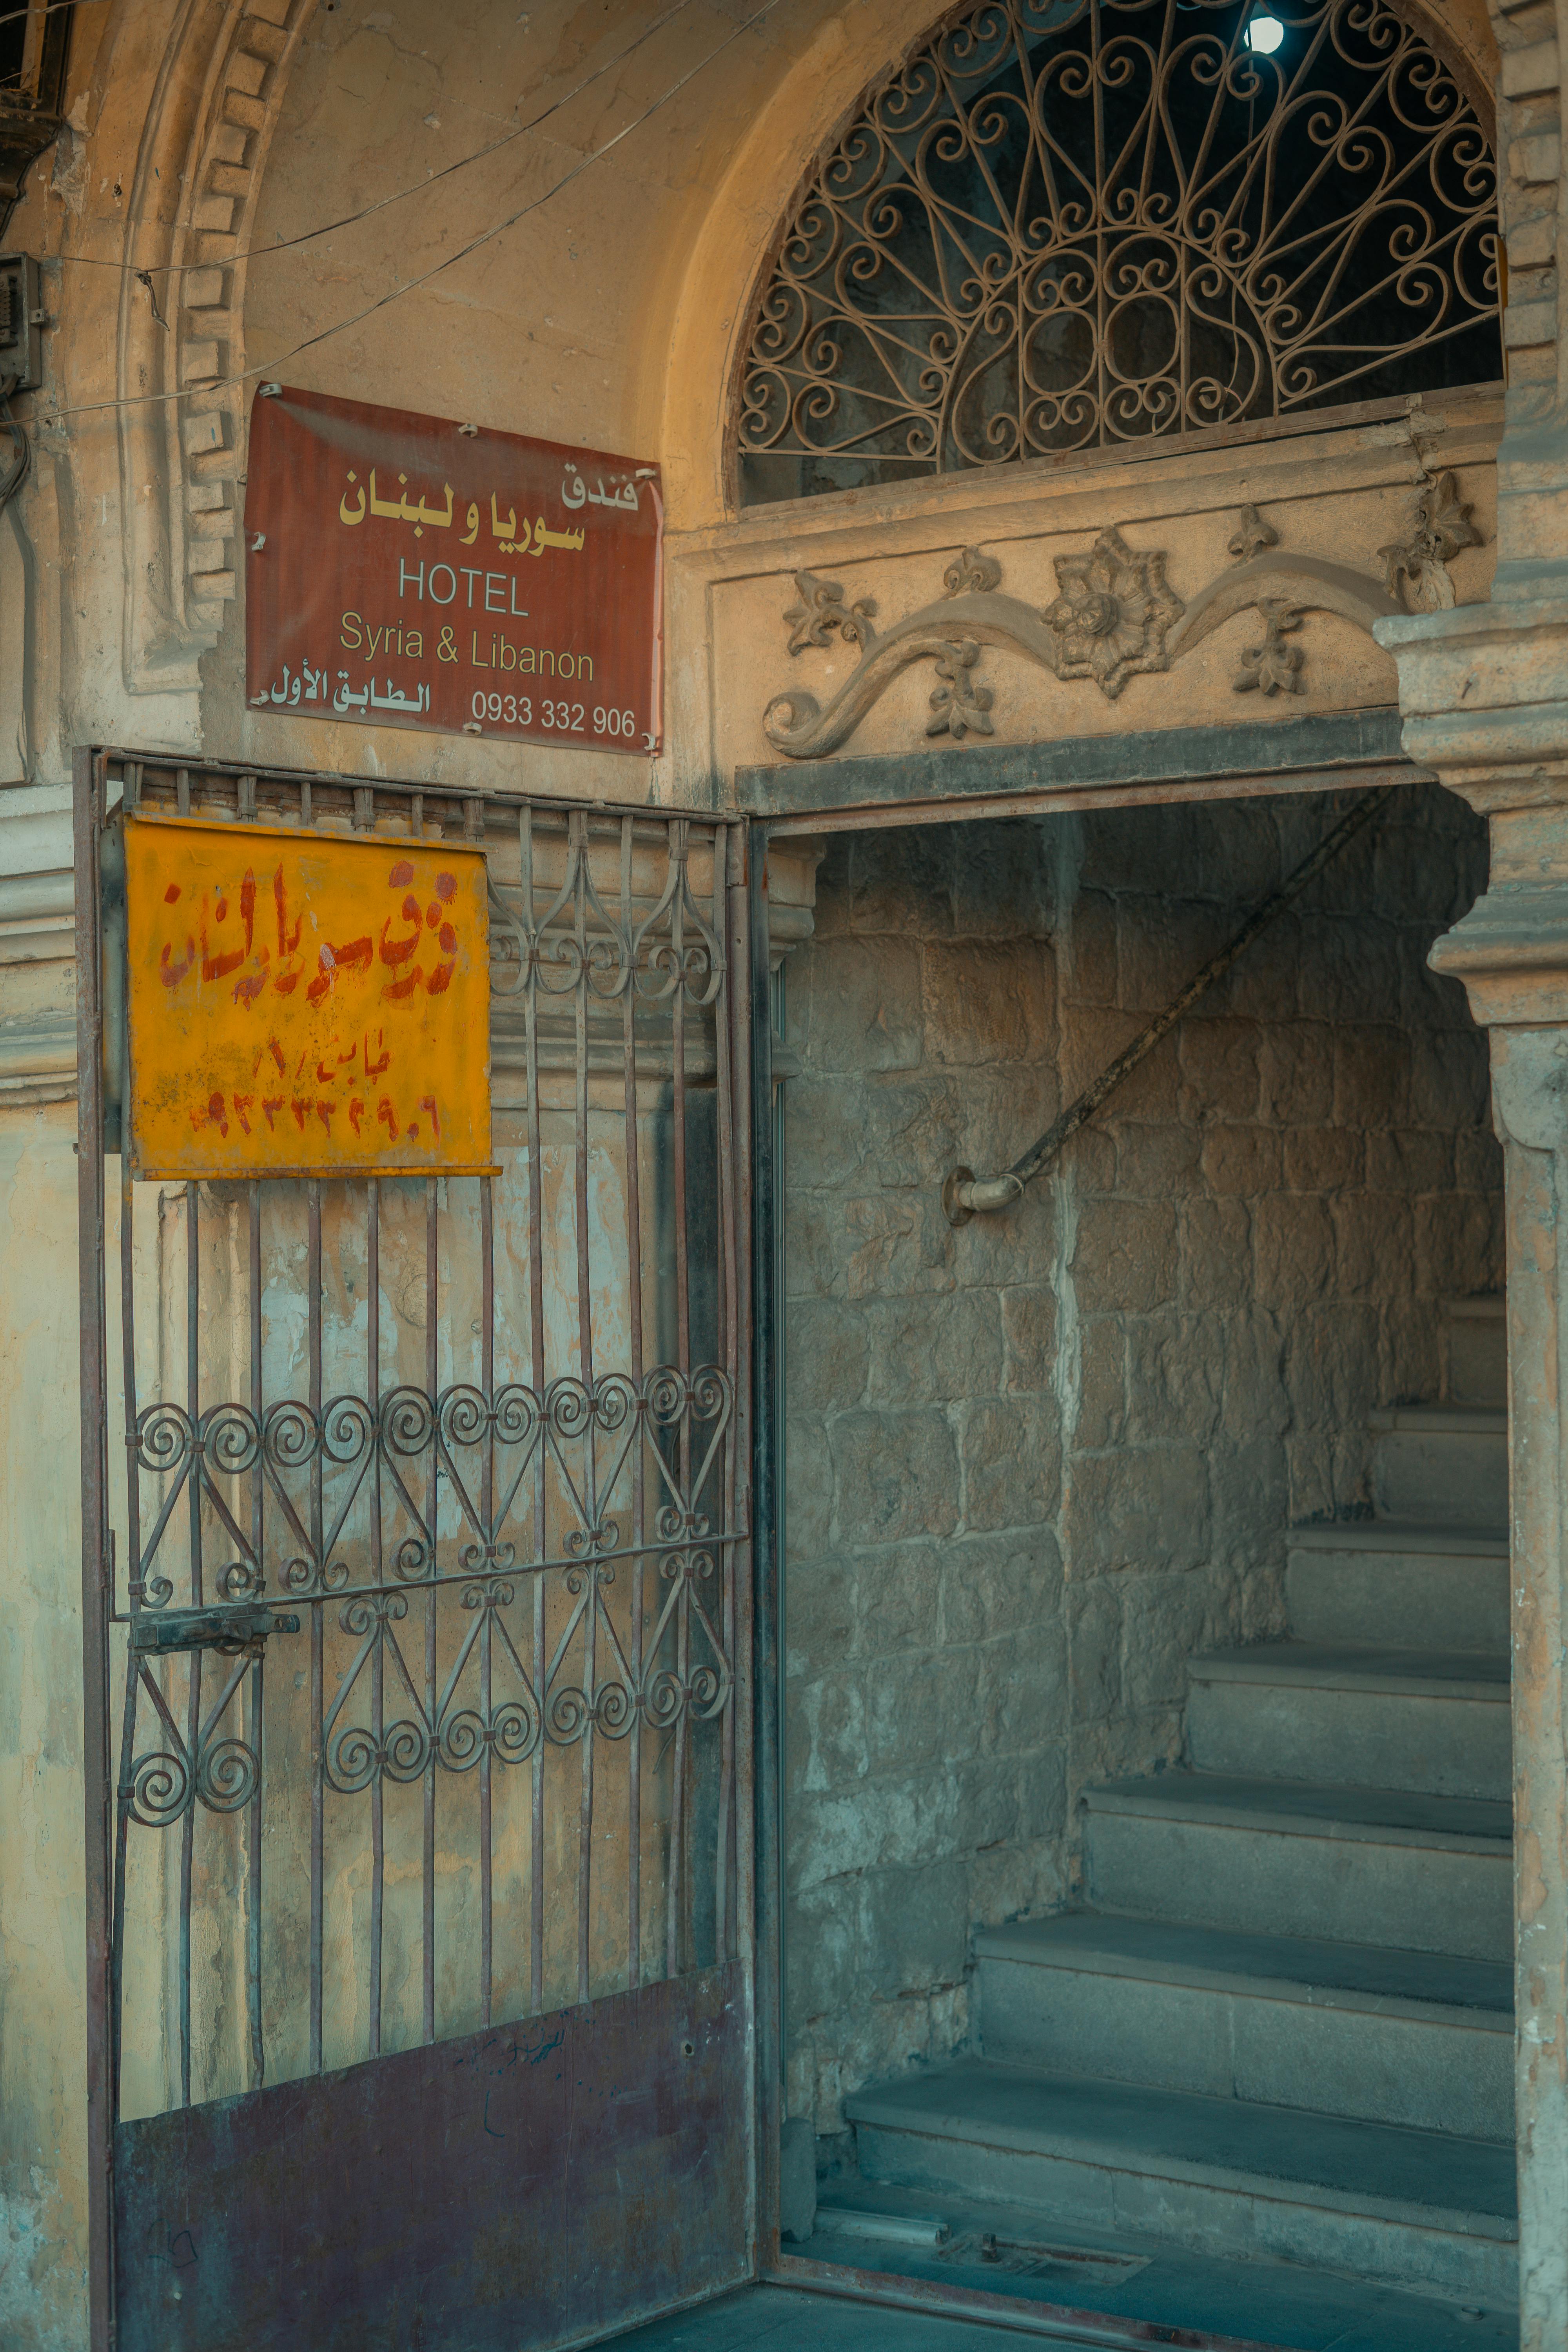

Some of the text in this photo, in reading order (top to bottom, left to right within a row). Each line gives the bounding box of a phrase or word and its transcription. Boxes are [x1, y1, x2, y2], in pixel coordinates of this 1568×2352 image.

[338, 467, 585, 557] سوريا و لبنان
[561, 463, 639, 511] فندق
[399, 557, 529, 617] HOTEL
[340, 611, 594, 682] Syria & Libanon
[271, 658, 430, 715] الطابق الأول
[472, 691, 635, 738] 0933 332 906
[379, 860, 458, 1000] فندق
